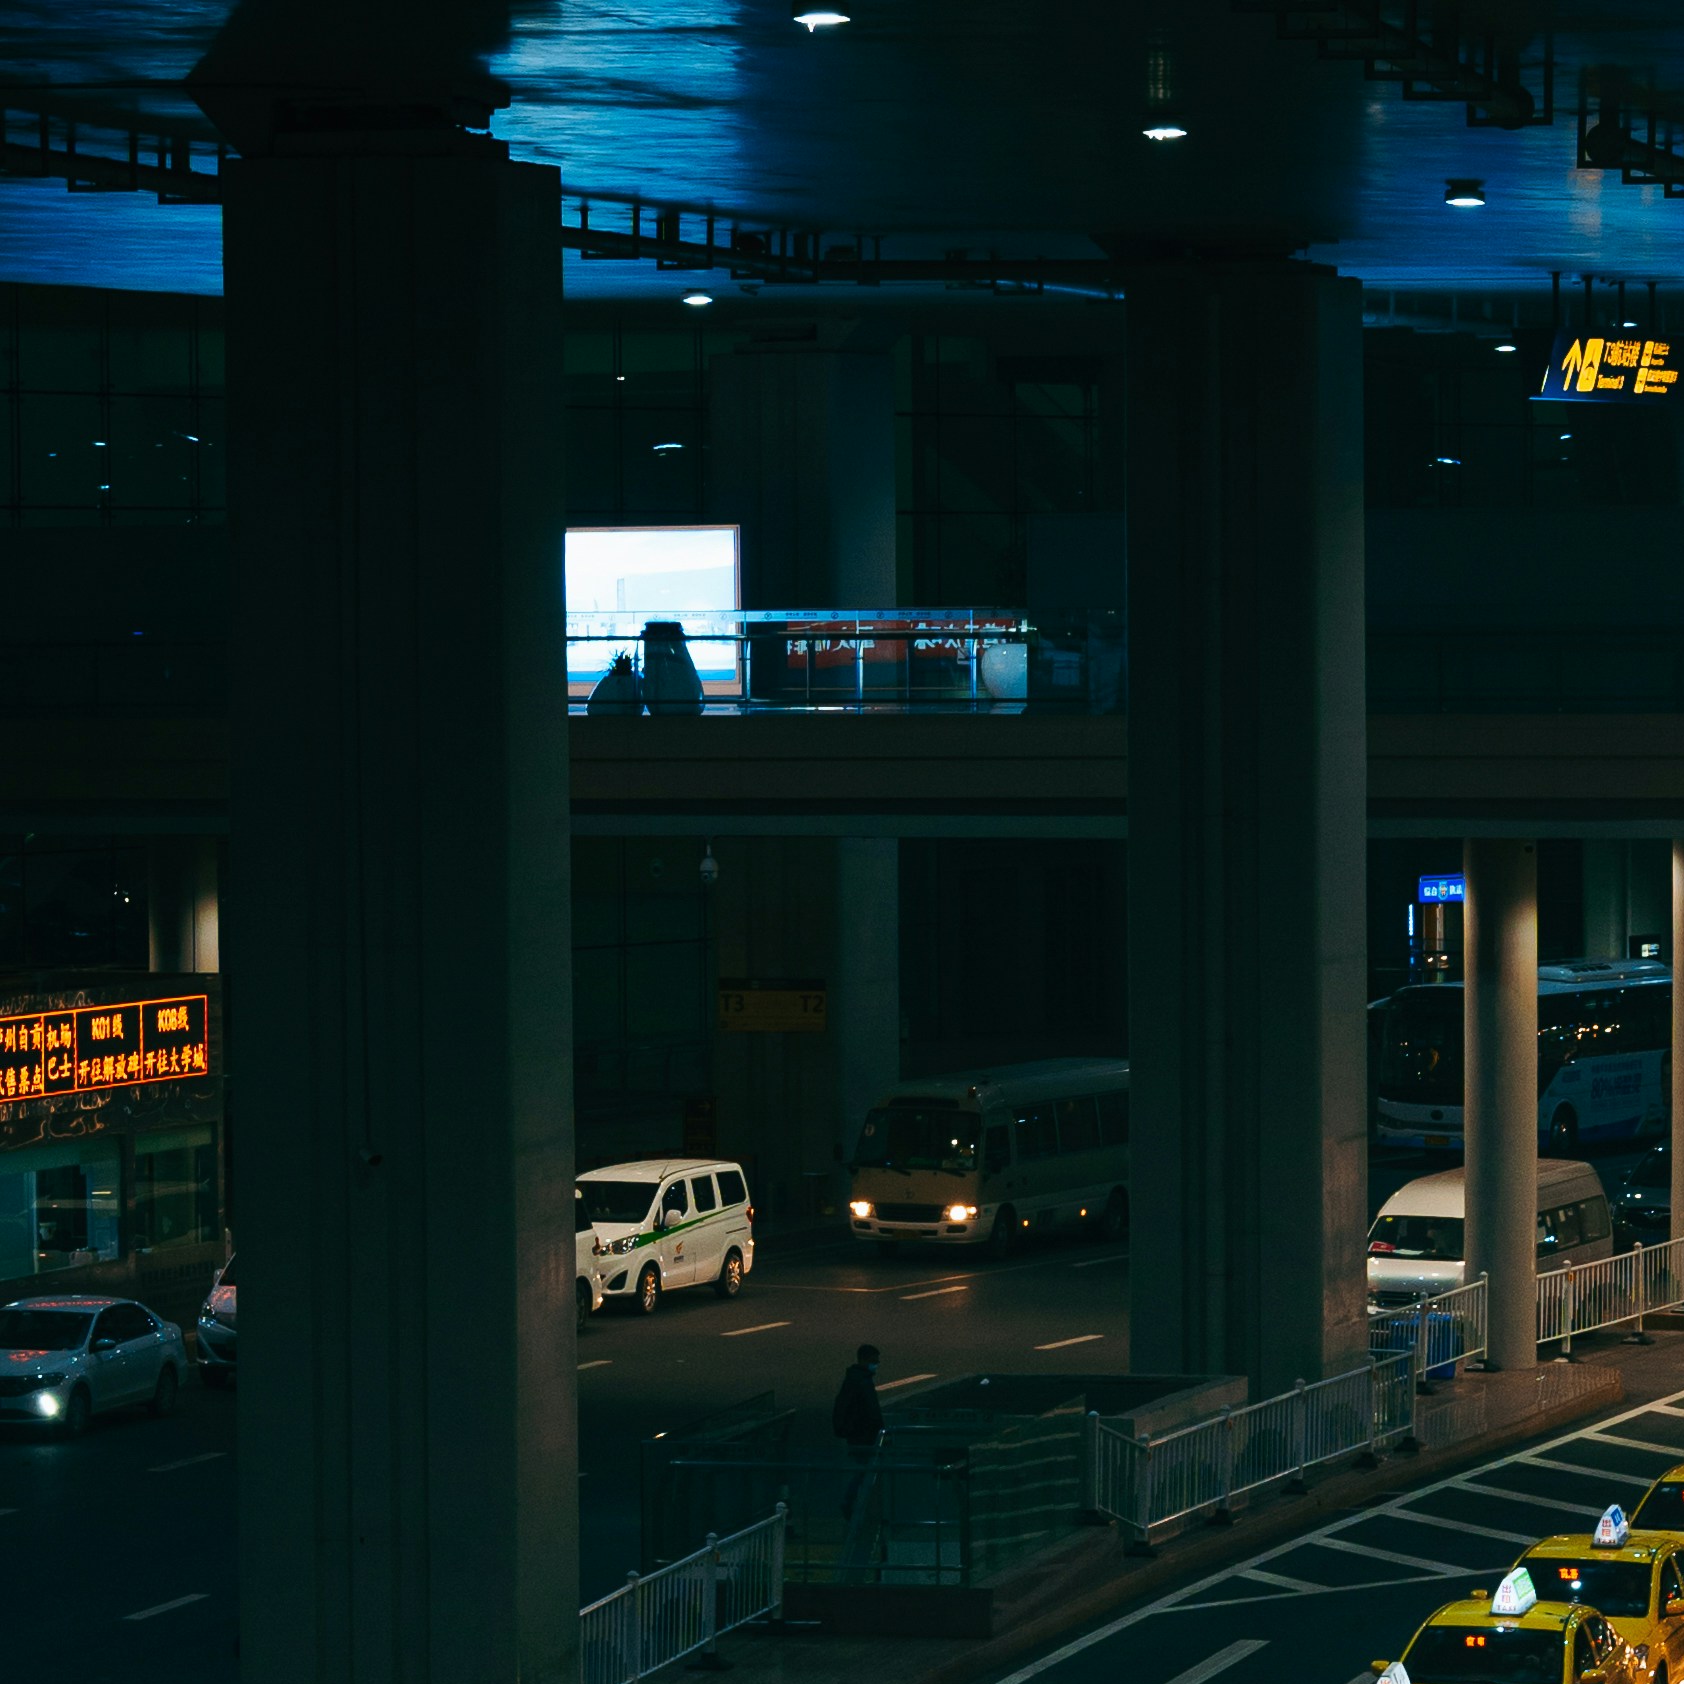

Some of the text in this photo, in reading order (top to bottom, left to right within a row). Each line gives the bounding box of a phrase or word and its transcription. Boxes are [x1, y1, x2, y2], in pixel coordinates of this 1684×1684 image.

[46, 1023, 72, 1051] 机场
[47, 1053, 72, 1080] 巴士
[78, 1051, 140, 1085] 开往解放碑
[144, 1043, 206, 1076] 开往大学城
